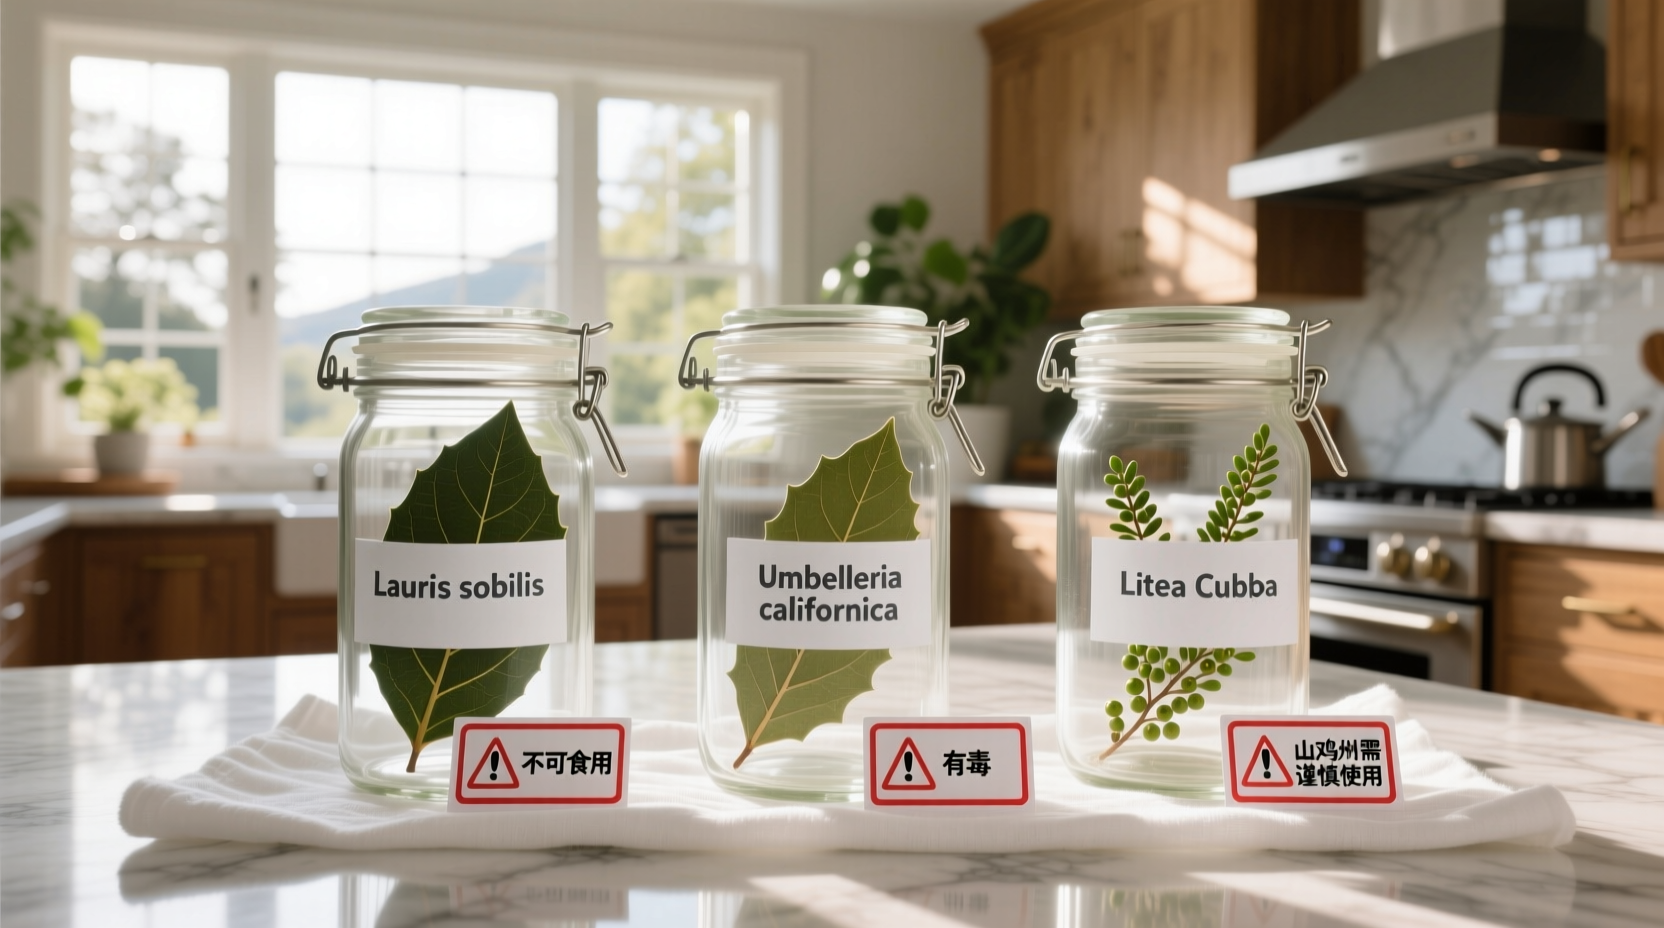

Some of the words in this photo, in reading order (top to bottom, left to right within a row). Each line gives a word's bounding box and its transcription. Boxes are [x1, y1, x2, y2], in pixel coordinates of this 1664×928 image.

[374, 570, 451, 599] Lauris
[459, 571, 544, 598] sobilis
[759, 564, 902, 591] Umbelleria
[1121, 570, 1186, 598] Litea
[1195, 572, 1277, 599] Cubba
[759, 595, 898, 622] californica
[521, 749, 613, 776] 不可食用
[942, 749, 992, 777] 有毒
